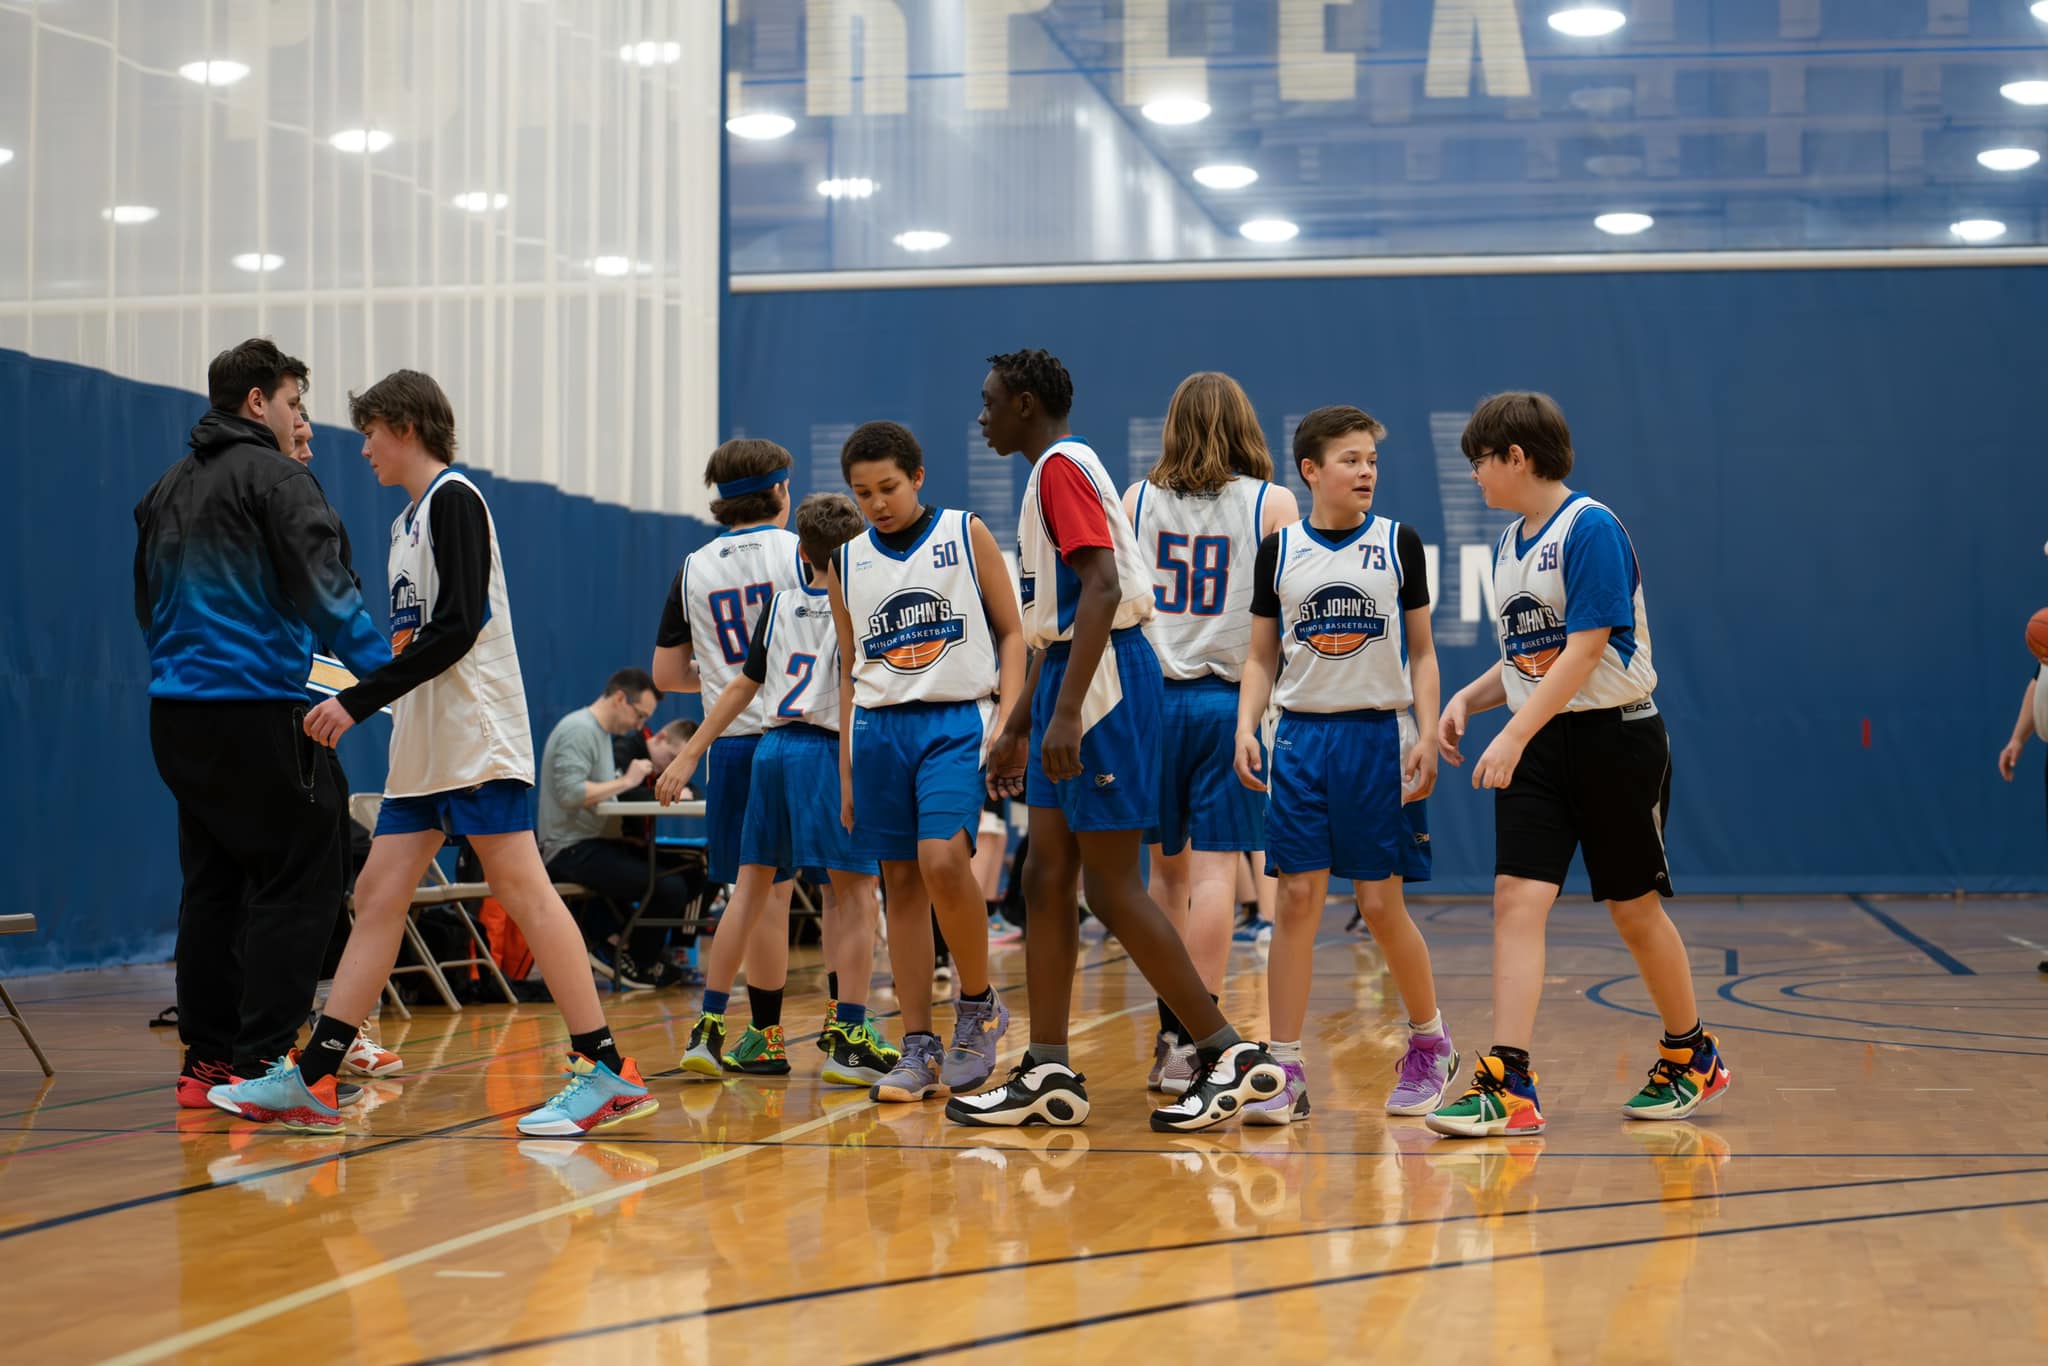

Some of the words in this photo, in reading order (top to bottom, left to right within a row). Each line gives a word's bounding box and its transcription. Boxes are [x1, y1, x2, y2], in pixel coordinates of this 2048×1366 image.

[932, 540, 959, 569] 50
[1358, 543, 1387, 570] 73
[1537, 541, 1558, 572] 59
[1153, 531, 1231, 616] 58
[869, 612, 894, 636] ST.
[895, 600, 951, 630] JOHN'S
[1300, 601, 1321, 622] ST.
[1323, 598, 1375, 617] JOHN'S
[1516, 606, 1556, 634] JOHN'S
[869, 638, 897, 651] MINOR
[900, 625, 958, 641] BASKETBALL
[1299, 623, 1324, 633] MINOR
[1325, 621, 1378, 630] BASKETBALL
[776, 652, 818, 719] 2
[1622, 702, 1652, 714] EAD
